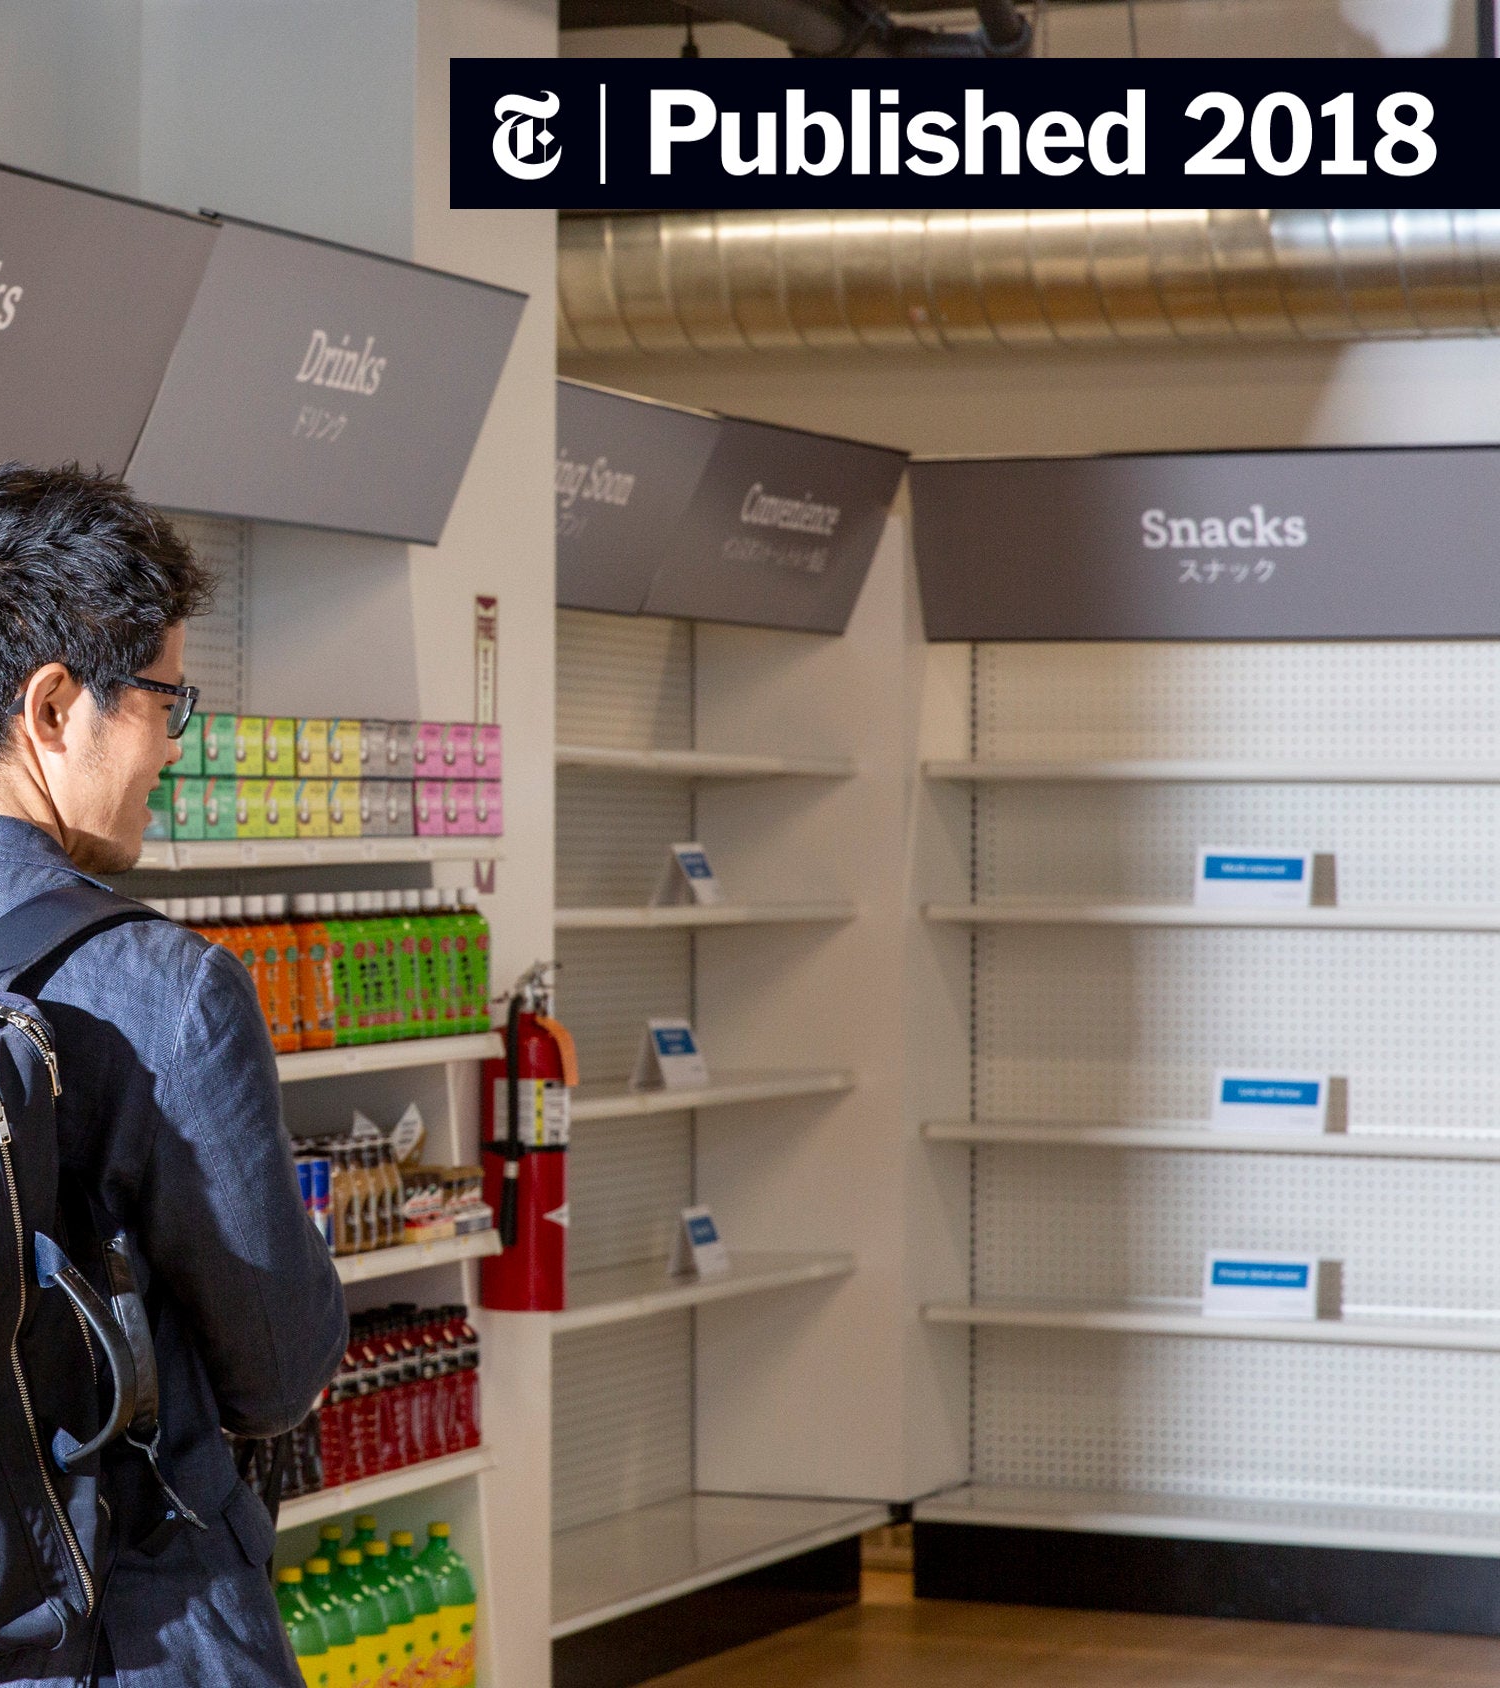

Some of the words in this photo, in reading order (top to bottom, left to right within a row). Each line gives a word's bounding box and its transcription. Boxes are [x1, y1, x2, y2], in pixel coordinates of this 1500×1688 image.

[296, 329, 388, 396] Drinks
[741, 481, 842, 536] Convenience
[1141, 504, 1308, 549] Snacks
[1178, 557, 1277, 584] スナック
